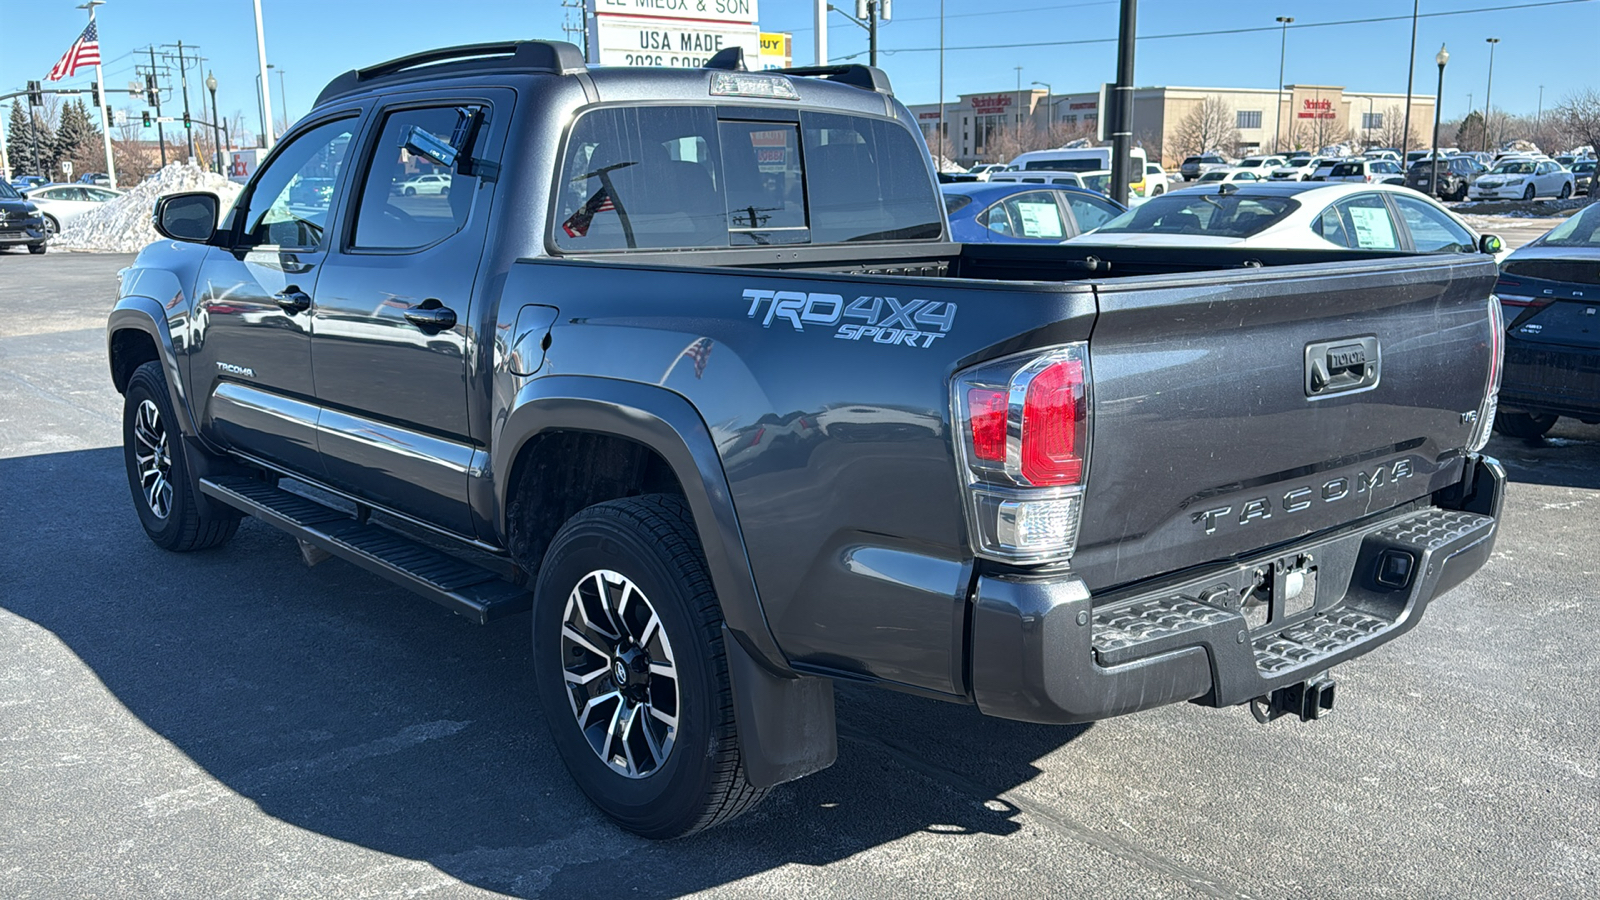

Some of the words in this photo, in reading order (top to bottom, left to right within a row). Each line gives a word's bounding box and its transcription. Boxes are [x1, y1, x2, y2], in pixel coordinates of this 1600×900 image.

[696, 0, 707, 12] &
[715, 0, 749, 14] SON
[640, 30, 671, 50] USA
[680, 32, 723, 52] MADE
[742, 288, 844, 332] TRD
[843, 296, 958, 332] 4X4
[833, 323, 947, 348] SPORT
[215, 361, 257, 378] TACOMA
[1333, 350, 1366, 367] TOYOTA
[1192, 458, 1414, 536] TACOMA
